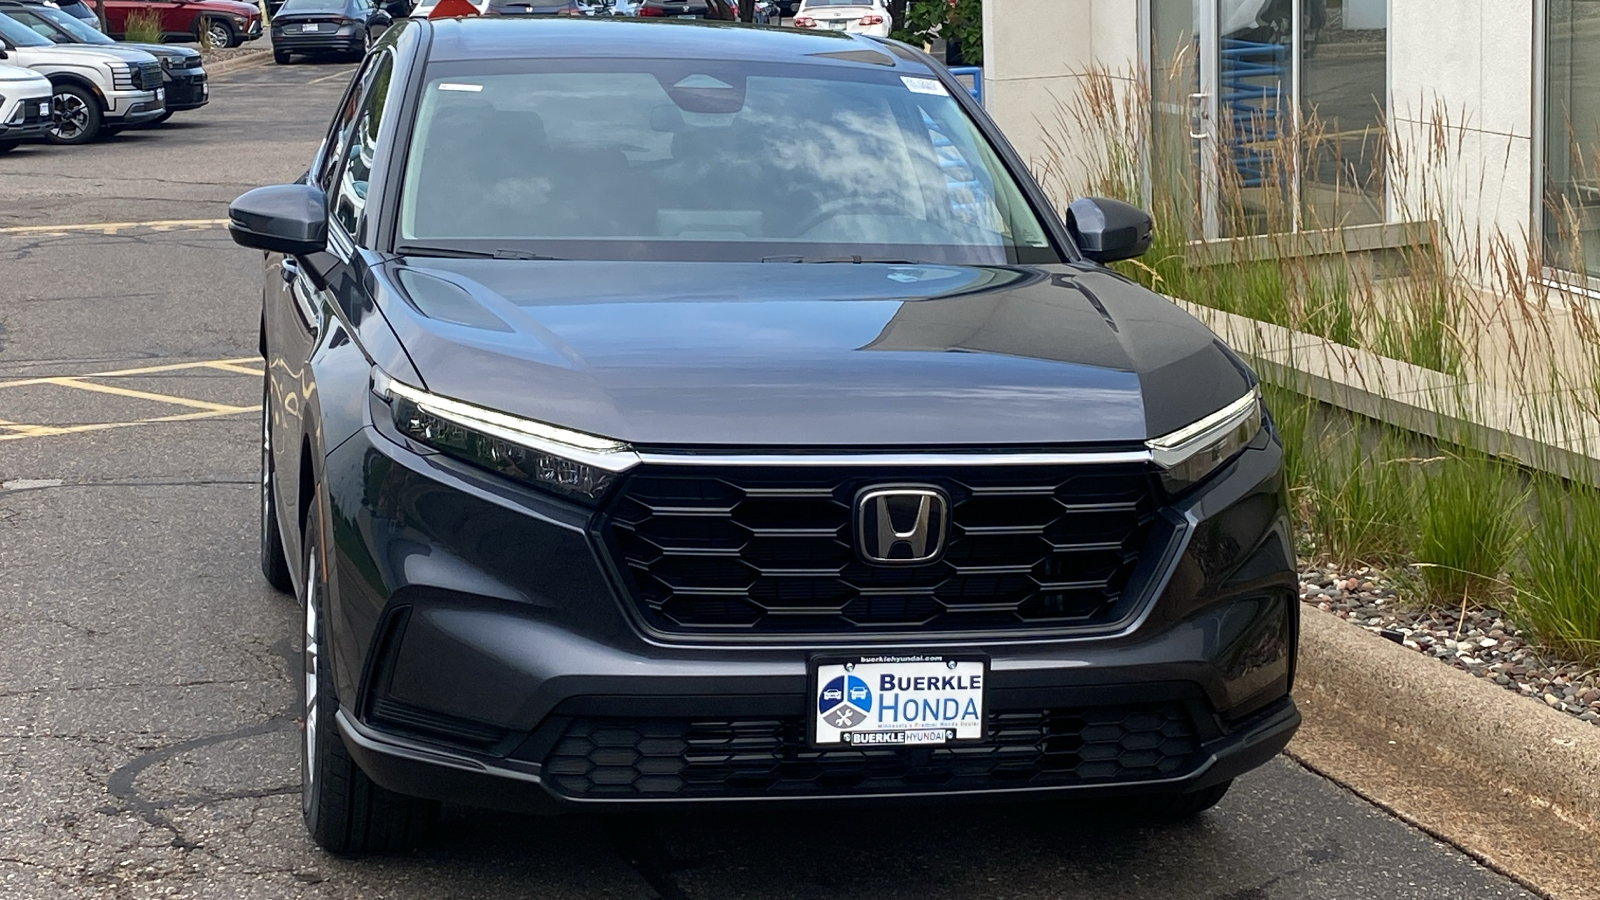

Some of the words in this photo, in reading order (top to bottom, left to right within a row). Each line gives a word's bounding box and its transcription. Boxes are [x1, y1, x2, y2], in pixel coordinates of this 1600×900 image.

[880, 674, 981, 691] BUERKLE
[878, 693, 979, 722] HONDA
[853, 732, 904, 743] BUERKLE
[906, 730, 945, 742] HYUNDAI
